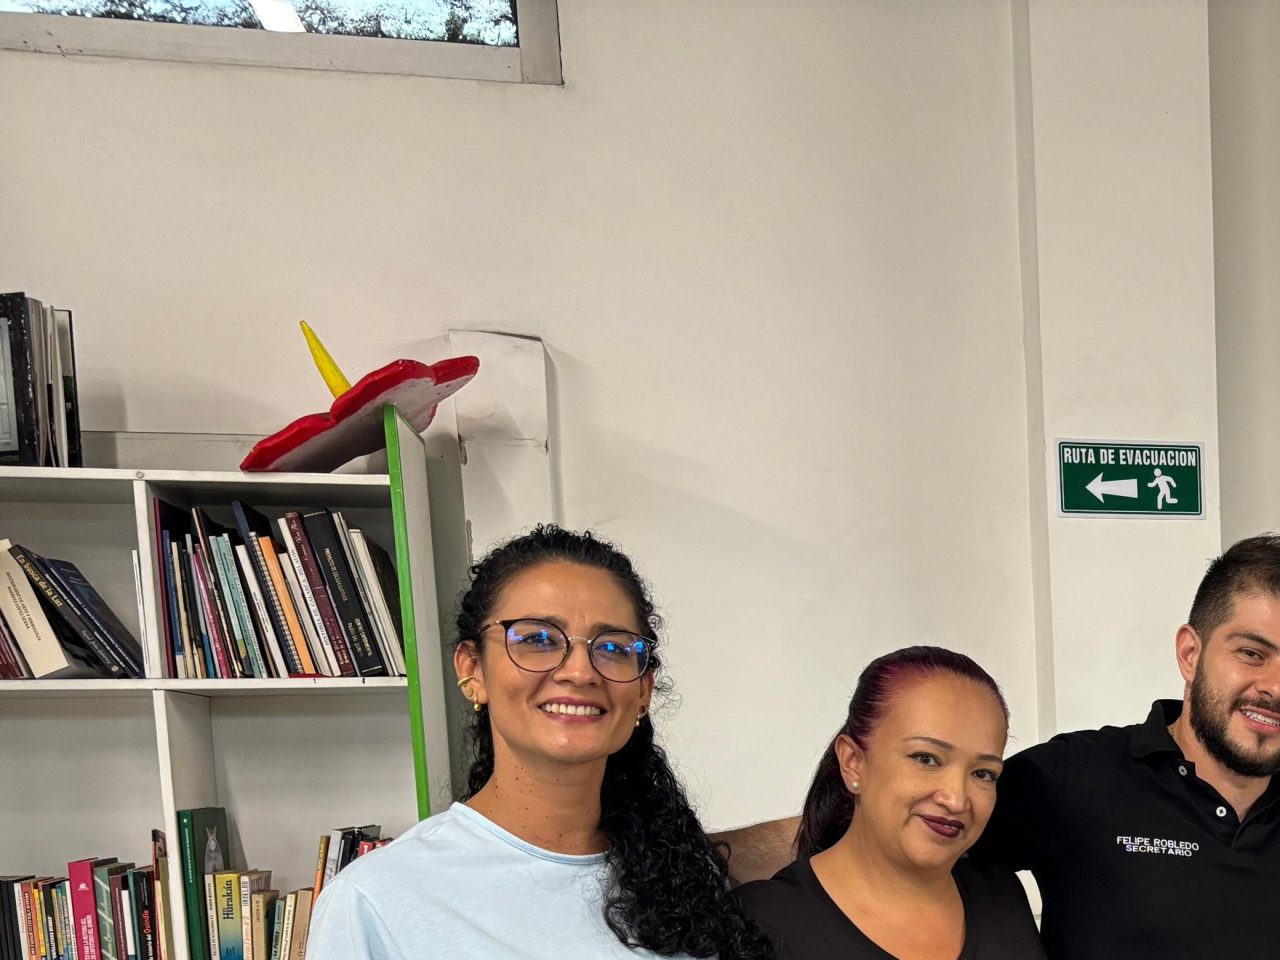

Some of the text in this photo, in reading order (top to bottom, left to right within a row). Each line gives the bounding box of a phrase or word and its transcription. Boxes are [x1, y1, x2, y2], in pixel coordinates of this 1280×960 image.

[1063, 447, 1196, 466] RUTA DE EVACUACION
[15, 552, 65, 608] En busca de la Luz
[314, 617, 330, 646] HISTORIA
[1116, 836, 1200, 851] FELIPE ROBLEDO
[1125, 844, 1192, 857] SECRETARIO
[144, 933, 152, 941] del
[145, 940, 154, 956] historia
